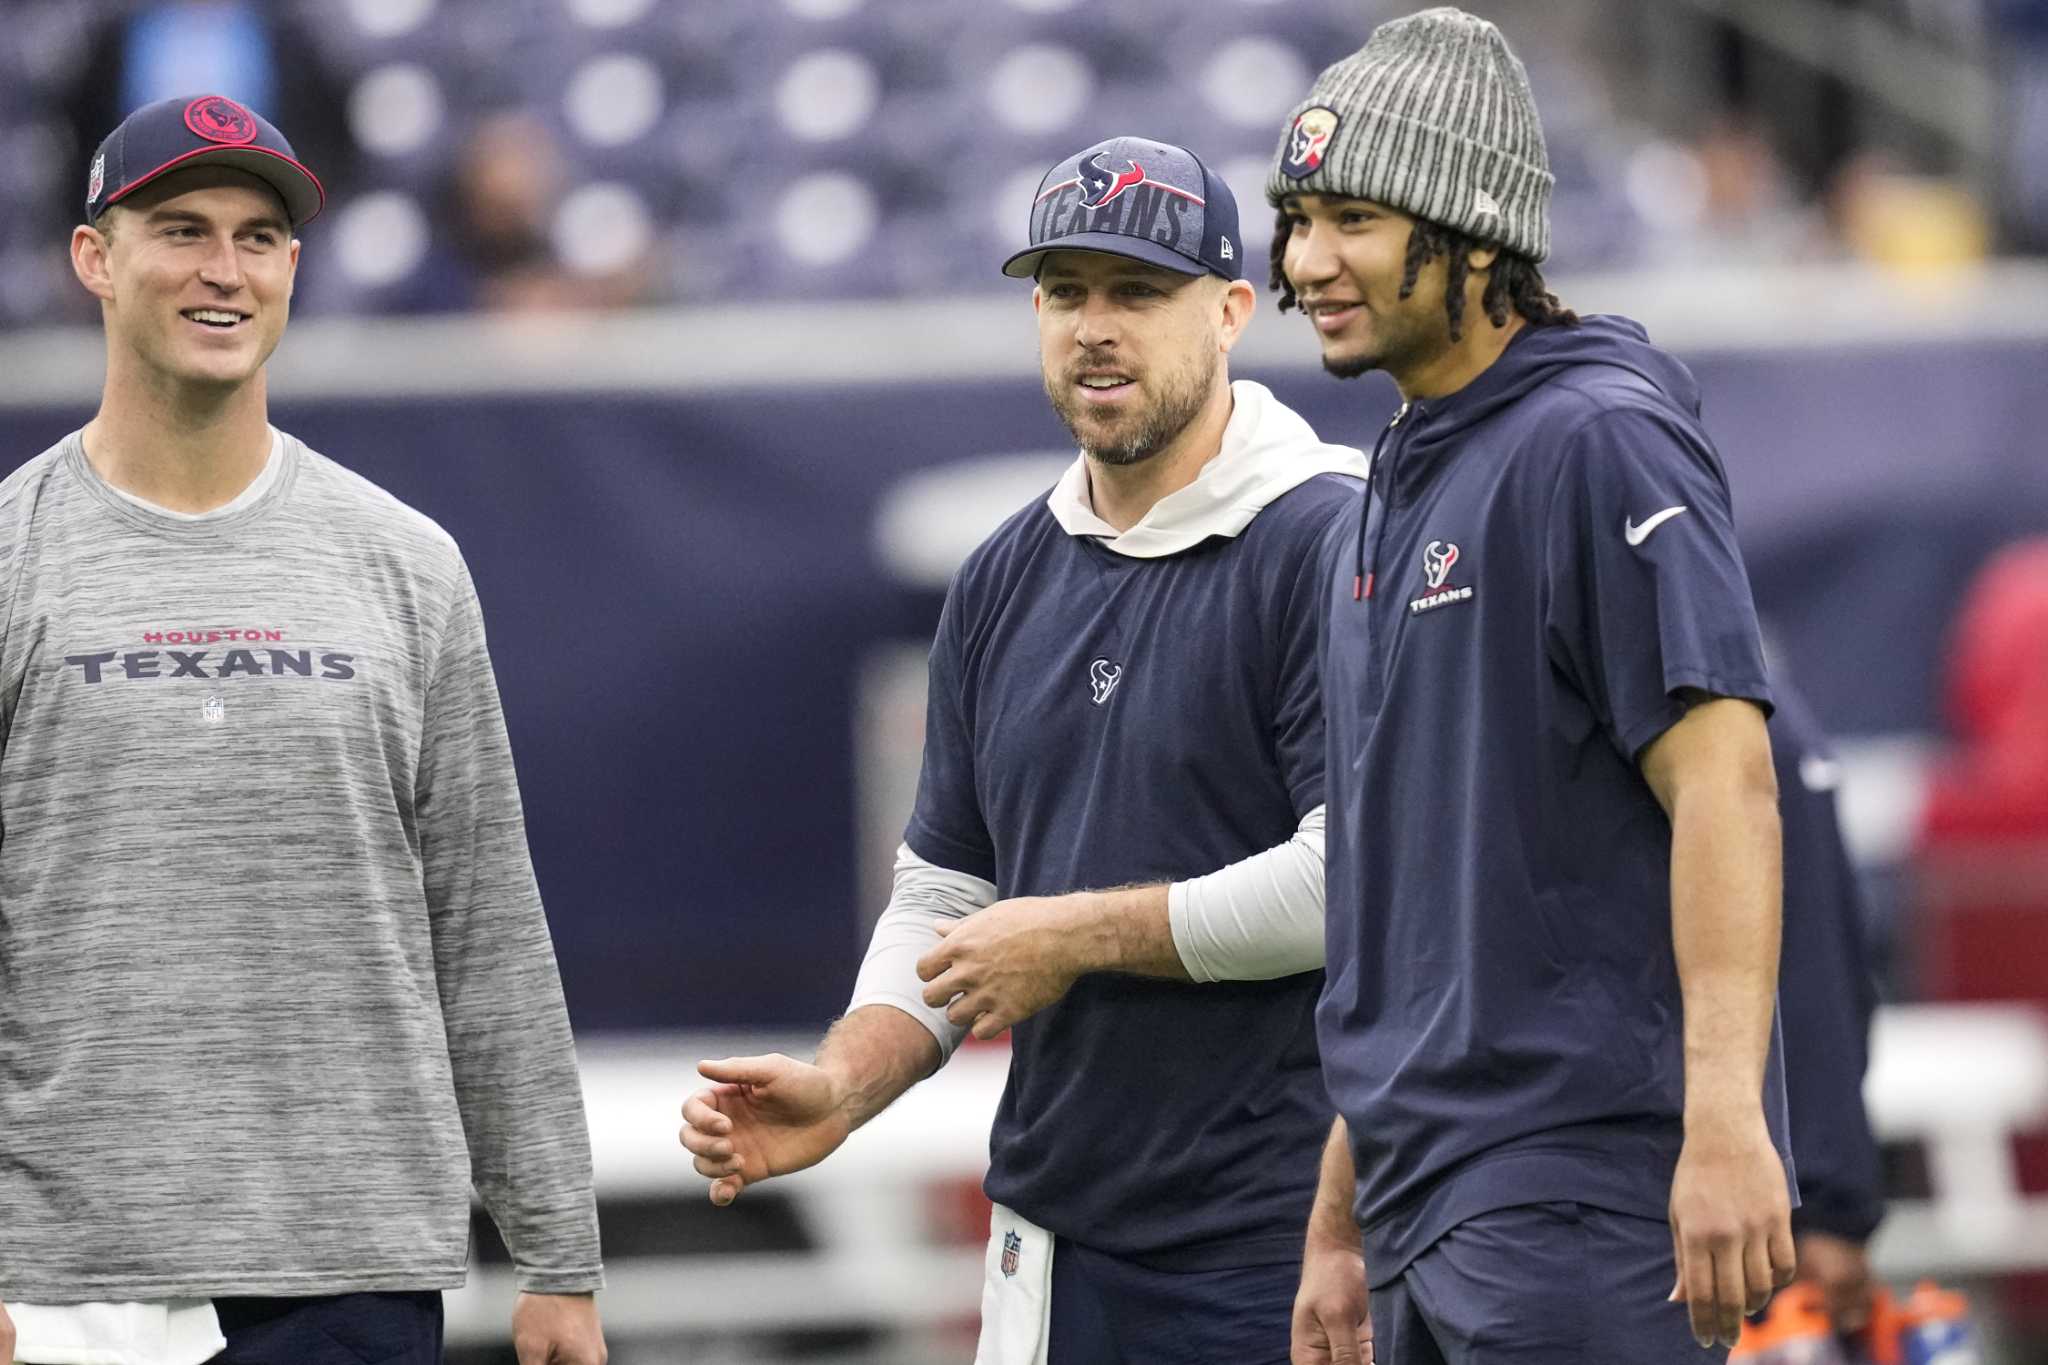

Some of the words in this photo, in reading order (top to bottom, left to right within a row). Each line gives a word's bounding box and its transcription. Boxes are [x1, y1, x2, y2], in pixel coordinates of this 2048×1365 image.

[1410, 586, 1473, 612] TEXANS
[143, 630, 281, 645] HOUSTON
[64, 650, 355, 684] TEXANS
